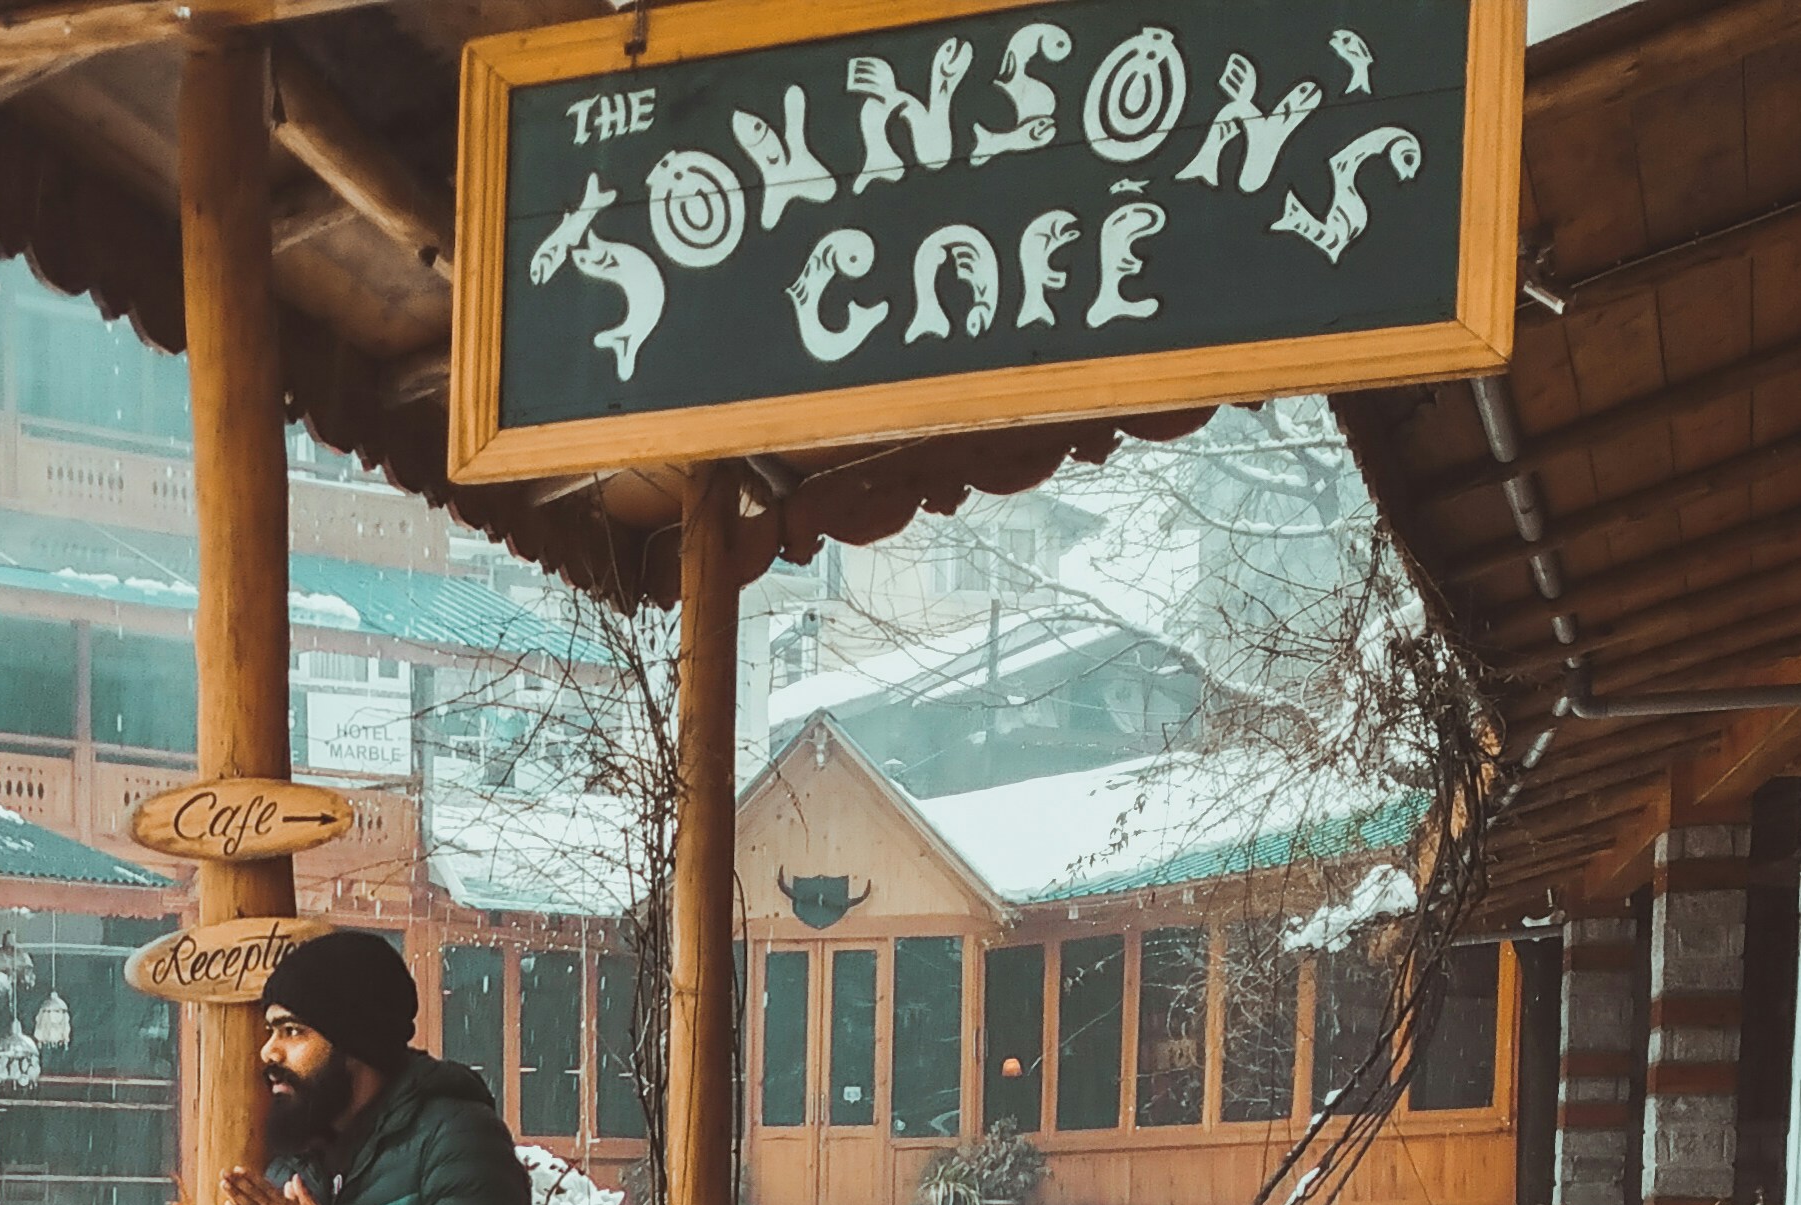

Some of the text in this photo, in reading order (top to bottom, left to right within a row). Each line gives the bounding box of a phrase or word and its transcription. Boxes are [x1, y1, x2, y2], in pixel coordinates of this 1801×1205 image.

[566, 87, 656, 145] THE
[529, 24, 1422, 382] JOHNSON'S
[329, 743, 403, 762] MARBLE
[336, 723, 395, 742] HOTEL
[173, 791, 278, 856] Cafe
[151, 920, 302, 991] Receptio
